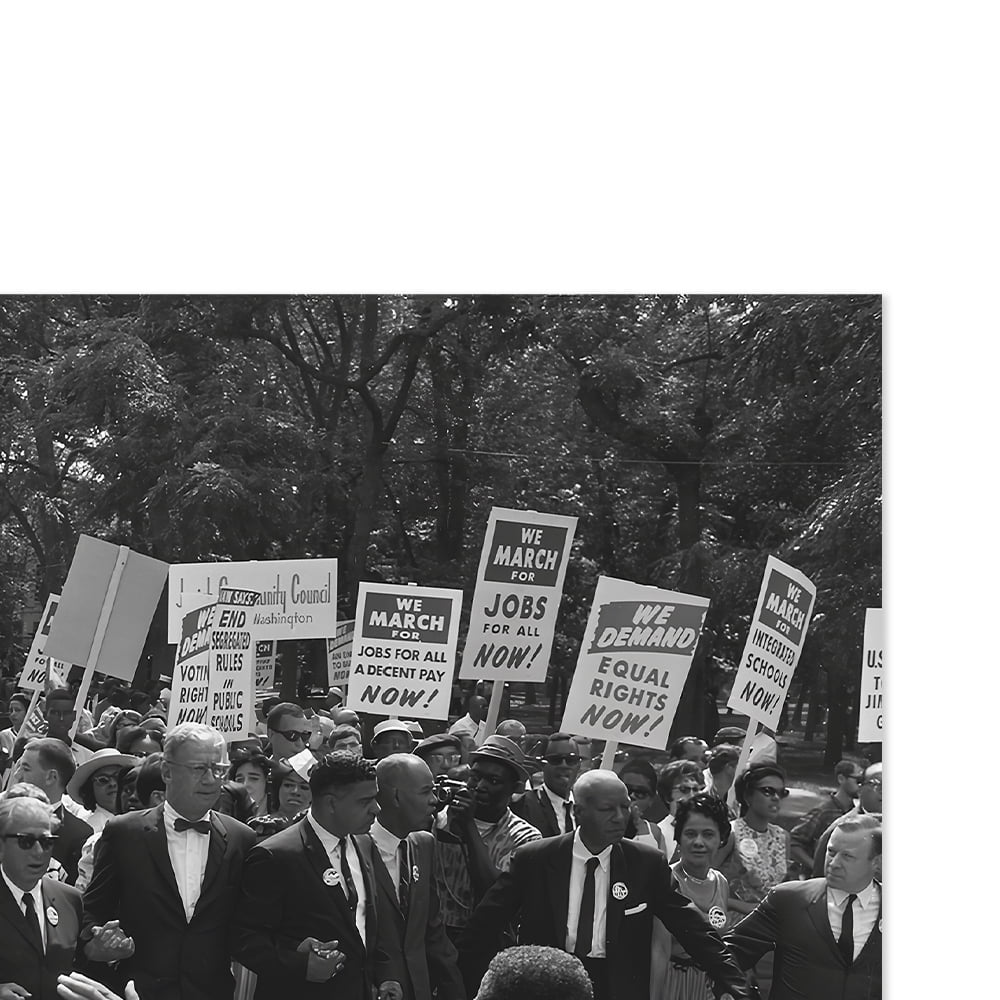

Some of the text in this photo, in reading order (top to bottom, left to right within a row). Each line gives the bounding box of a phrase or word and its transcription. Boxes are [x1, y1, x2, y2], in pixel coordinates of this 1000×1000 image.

[521, 527, 543, 546] WE
[493, 545, 559, 571] MARCH
[511, 570, 536, 582] FOR
[291, 572, 331, 604] Council
[787, 582, 802, 603] WE
[396, 597, 423, 612] WE
[484, 593, 548, 620] JOBS
[632, 604, 675, 625] WE
[765, 592, 805, 631] MARCH
[197, 606, 216, 630] WE
[219, 610, 246, 628] END
[253, 612, 313, 629] Washington
[368, 611, 445, 632] MARCH
[775, 619, 791, 635] FOR
[391, 629, 420, 640] FOR
[482, 623, 540, 637] FOR ALL
[597, 626, 696, 649] DEMAND
[211, 631, 250, 650] SEGREGATED
[216, 653, 243, 671] RULES
[357, 646, 447, 663] JOBS FOR ALL
[473, 642, 543, 669] NOW!
[354, 663, 365, 675] A
[366, 665, 415, 680] DECENT
[419, 669, 446, 683] PAY
[597, 656, 670, 689] EQUAL
[745, 653, 788, 689] SCHOOLS
[223, 679, 234, 688] IN
[179, 686, 209, 703] RIGHT
[213, 691, 243, 711] PUBLIC
[360, 685, 439, 708] NOW!
[589, 678, 668, 711] RIGHTS
[740, 680, 780, 715] NOW!
[210, 713, 243, 733] SCHOOLS
[580, 703, 664, 738] NOW!
